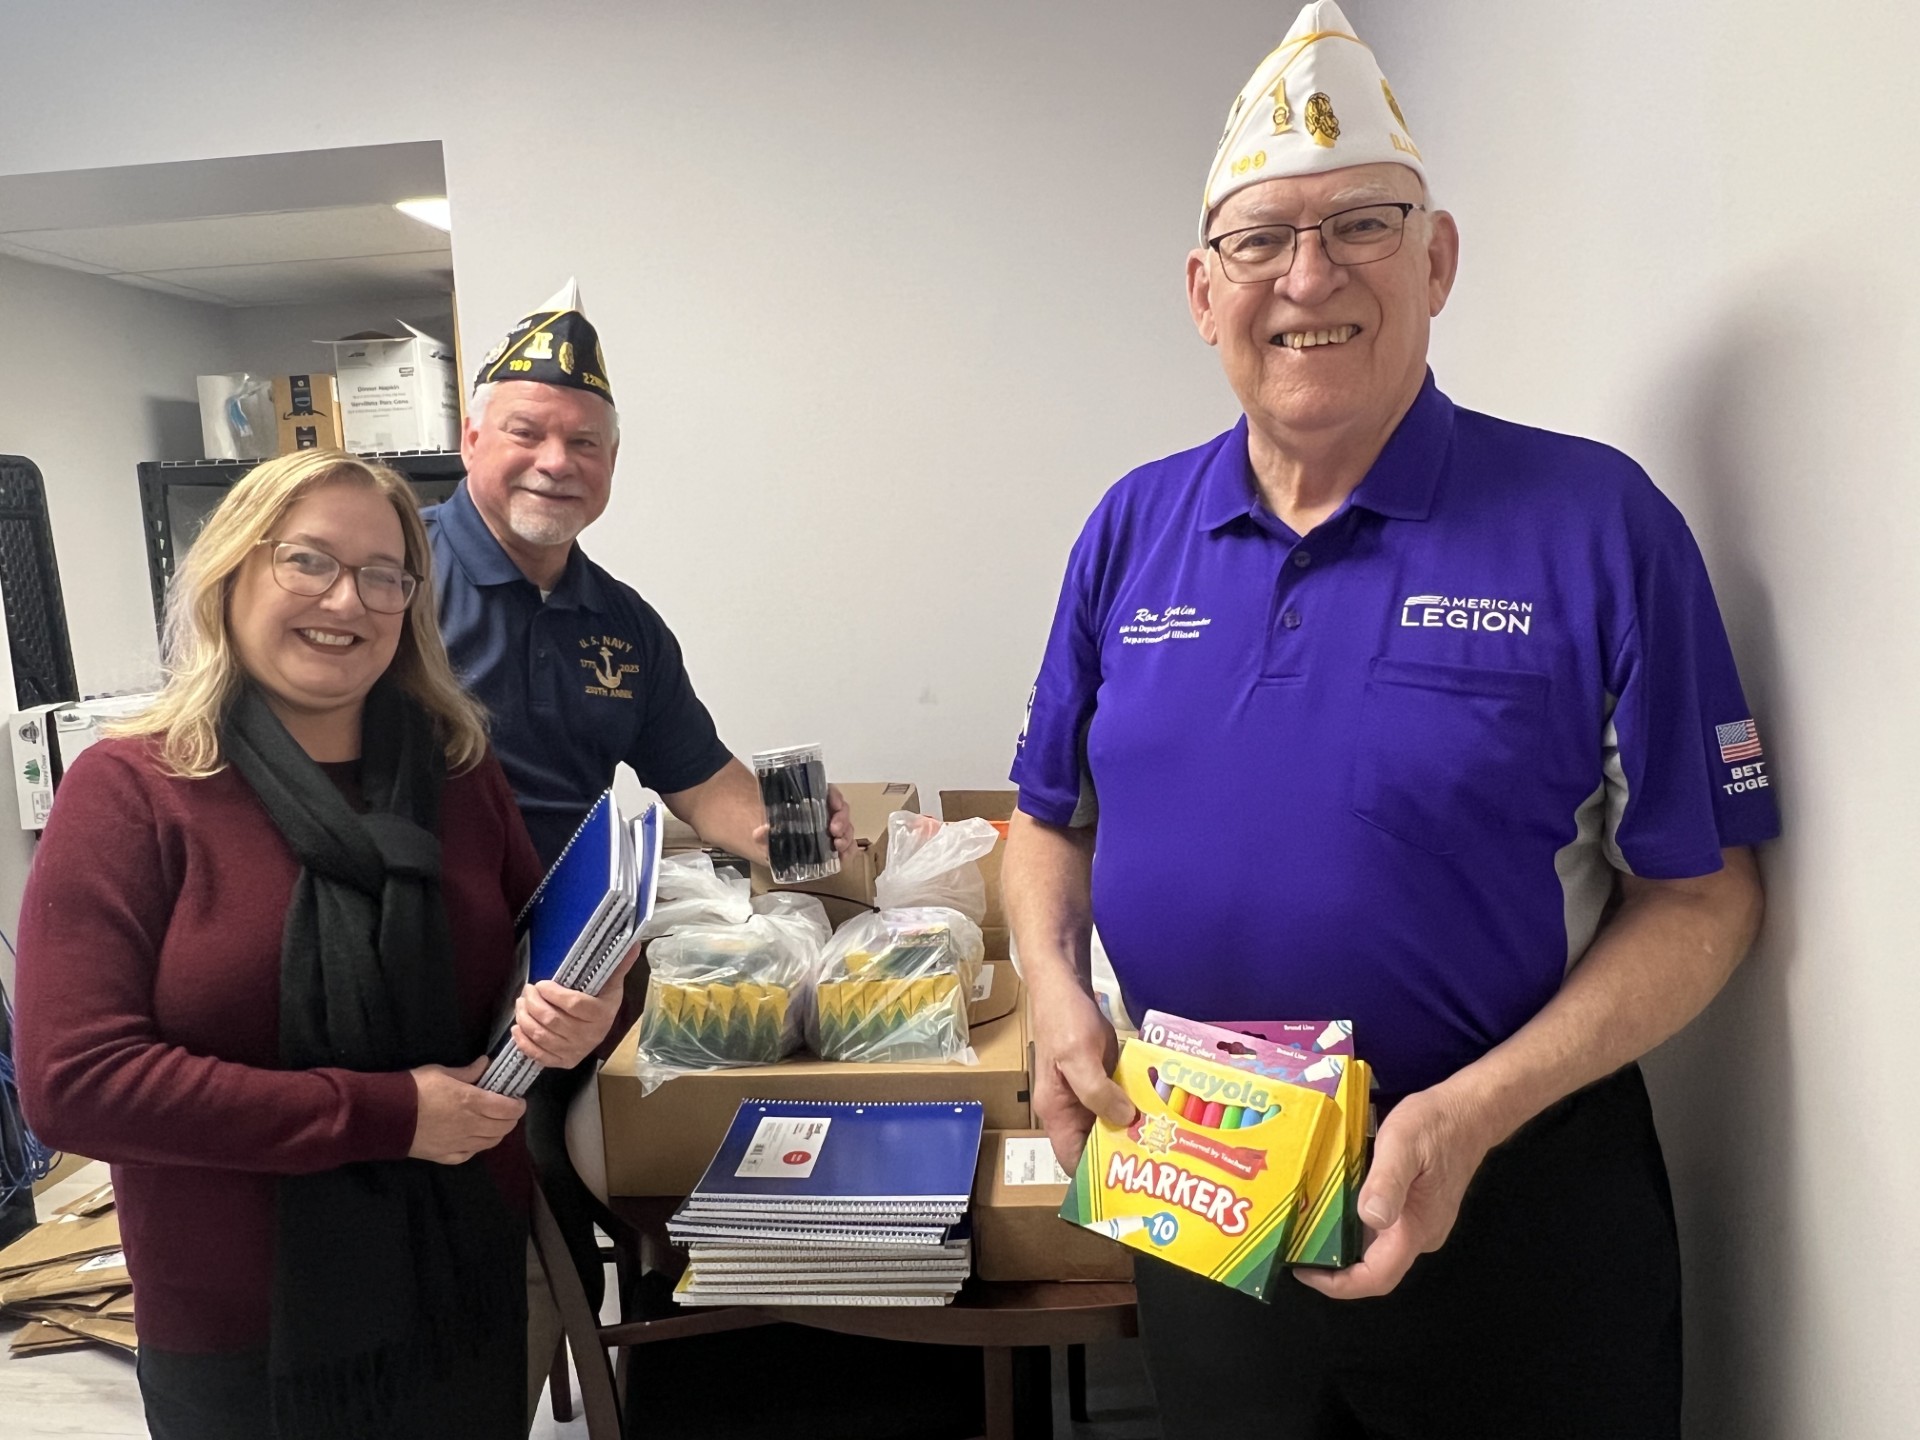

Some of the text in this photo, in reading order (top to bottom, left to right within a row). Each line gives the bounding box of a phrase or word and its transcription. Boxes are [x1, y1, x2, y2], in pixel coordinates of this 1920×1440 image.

[509, 359, 532, 371] 199
[1440, 597, 1533, 613] AMERICAN
[1401, 606, 1531, 636] LEGION
[602, 635, 633, 653] NAVY
[1171, 630, 1200, 639] Illinois
[1731, 761, 1766, 780] BET
[1723, 775, 1769, 796] TOGE
[1143, 1022, 1165, 1046] 10
[1160, 1058, 1269, 1109] Crayola
[1106, 1152, 1251, 1236] MARKERS
[1151, 1215, 1176, 1241] 10
